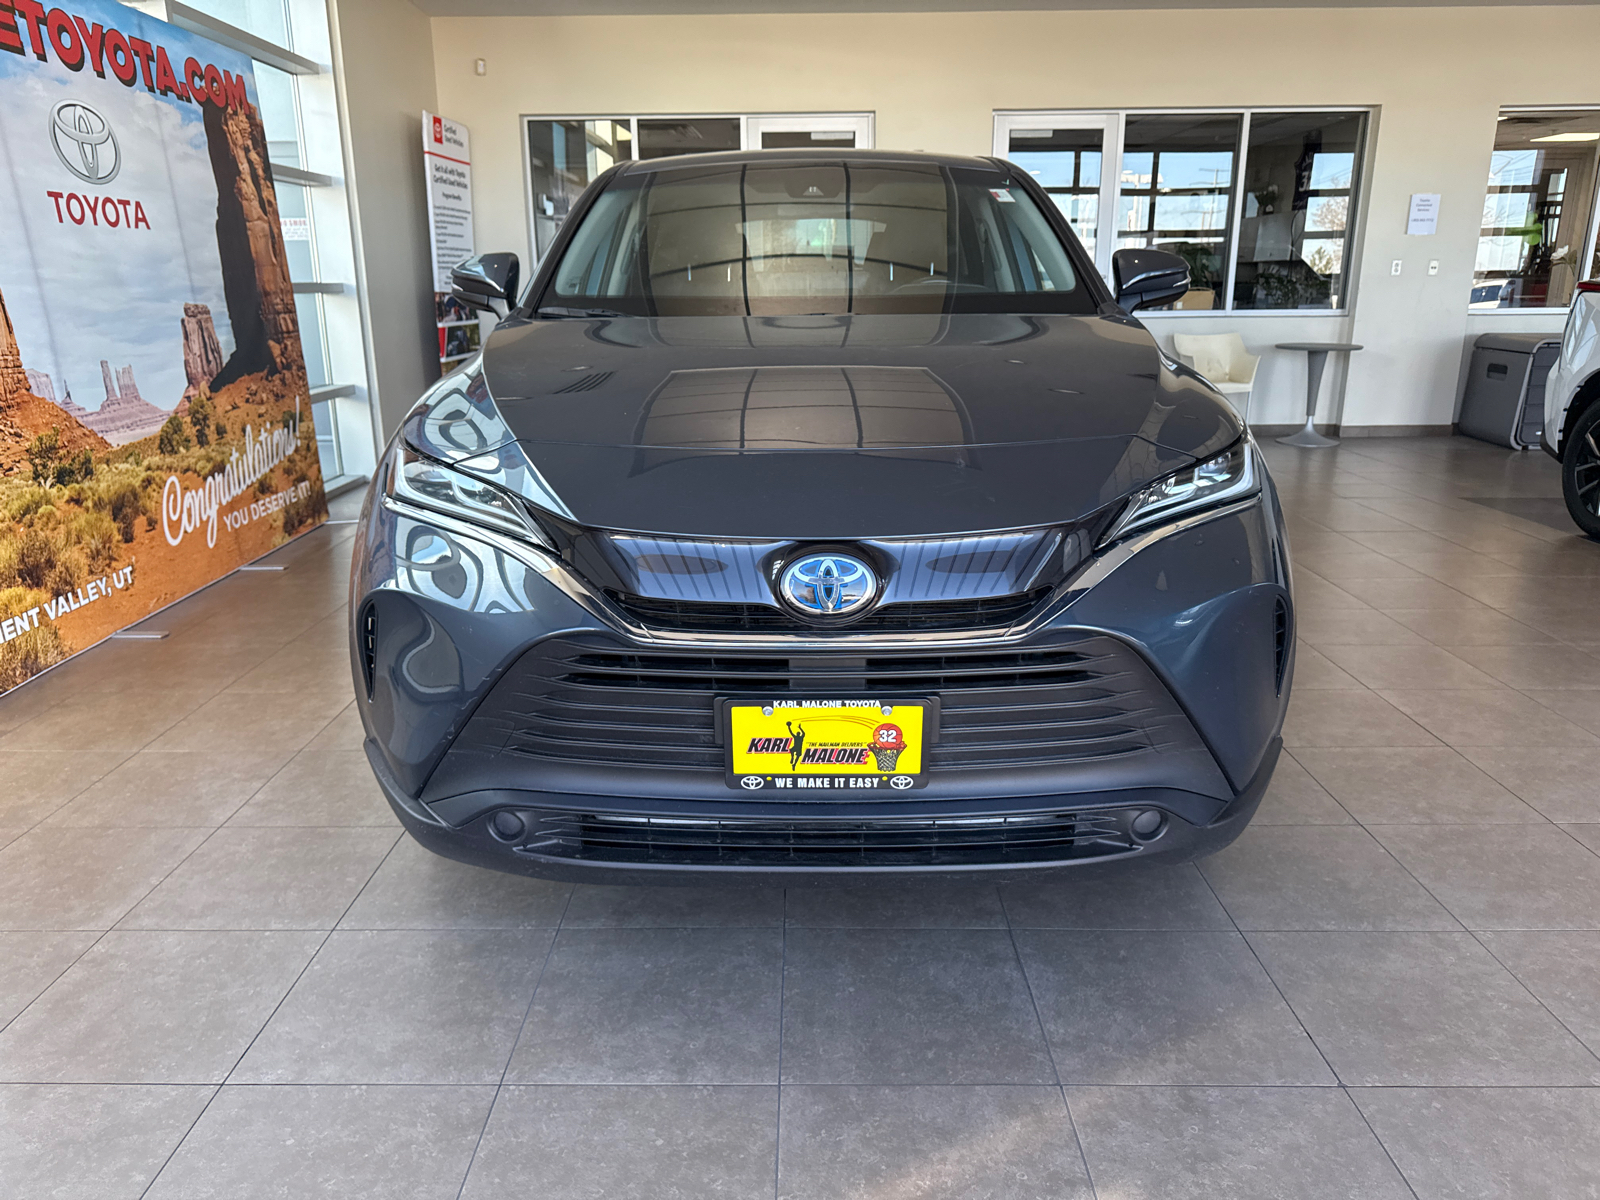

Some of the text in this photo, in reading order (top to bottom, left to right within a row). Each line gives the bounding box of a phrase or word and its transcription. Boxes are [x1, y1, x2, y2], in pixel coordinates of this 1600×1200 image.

[46, 190, 151, 230] TOYOTA
[163, 395, 300, 549] Congratulations!
[223, 480, 311, 532] YOU DESERVE IT!
[43, 576, 112, 621] VALLEY,
[112, 565, 133, 589] UT
[773, 700, 881, 708] KARL MALONE TOYOTA
[879, 729, 898, 743] 32
[747, 737, 792, 754] KARL
[801, 748, 869, 764] MALONE
[775, 777, 879, 788] WE MAKE IT EASY
